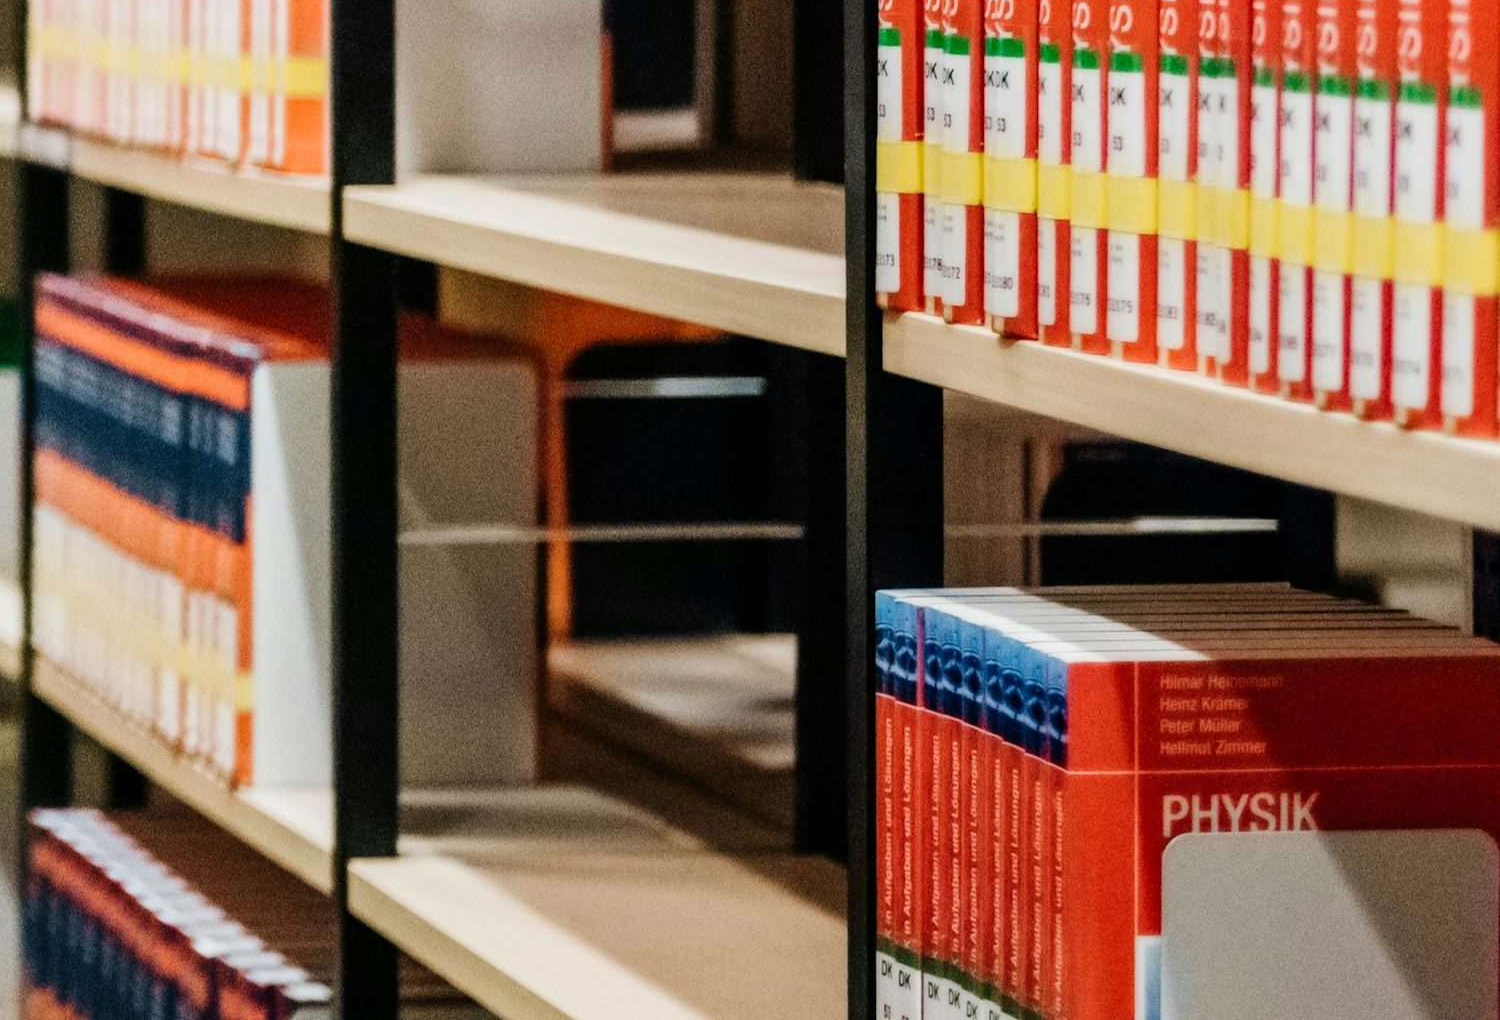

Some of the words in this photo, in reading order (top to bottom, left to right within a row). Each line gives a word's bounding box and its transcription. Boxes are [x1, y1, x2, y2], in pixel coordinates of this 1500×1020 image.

[1160, 718, 1195, 734] Peter
[1162, 791, 1321, 838] PHYSIK
[881, 959, 893, 979] DK
[898, 970, 911, 991] DK
[928, 981, 940, 1001] DK
[948, 987, 961, 1009] DK
[966, 1000, 978, 1020] DK
